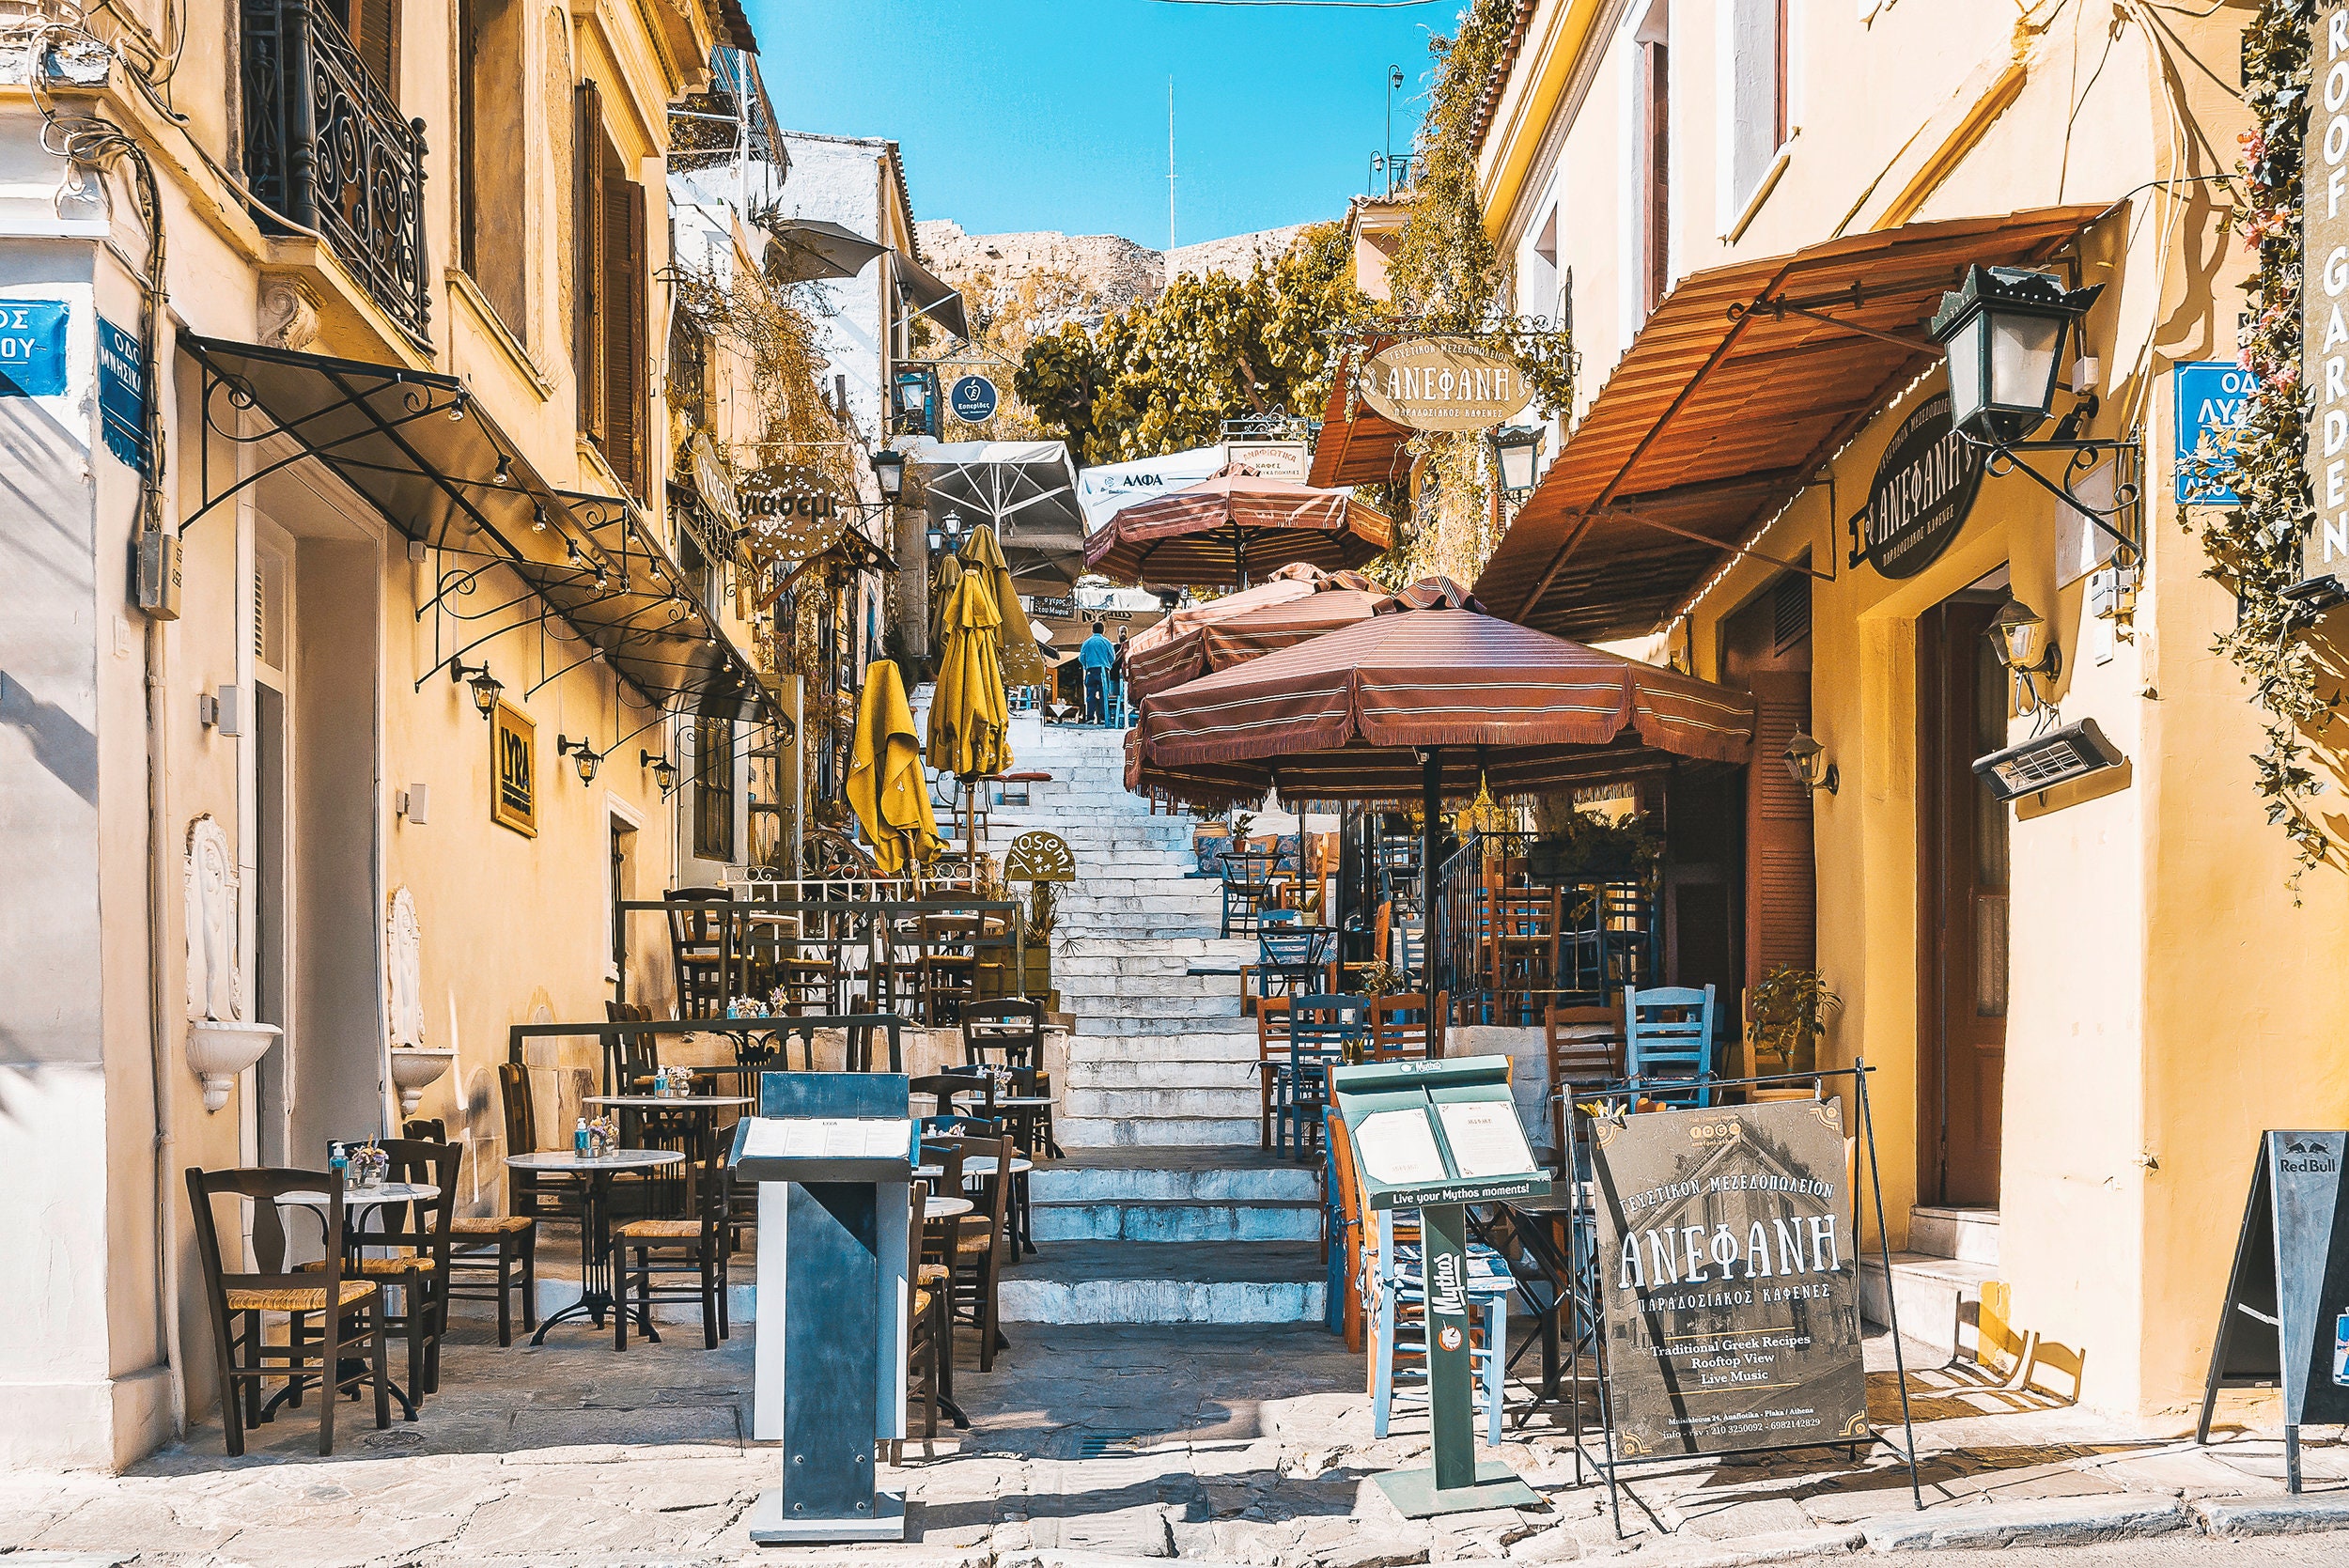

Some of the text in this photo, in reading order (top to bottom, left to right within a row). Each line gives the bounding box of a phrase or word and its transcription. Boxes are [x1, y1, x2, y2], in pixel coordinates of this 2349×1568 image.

[2322, 8, 2349, 565] ROOF GARDEN
[1385, 366, 1510, 401] ΑΝΕΦΑΝΗ
[1123, 474, 1163, 487] ΑΛΦΑ
[1878, 431, 1960, 545] ΑΝΕΦΑΝΗ
[2280, 1158, 2336, 1172] Red Bull
[1392, 1183, 1530, 1204] Live your Mythos moments!
[1619, 1174, 1835, 1215] ΓΕΥΣΤΙΚΟΝ ΜΕΖΕΔΟΠΩΛΕΙΟΝ
[1618, 1214, 1842, 1290] ΑΝΕΦΑΝΗ
[1431, 1252, 1466, 1315] Mythos
[1763, 1283, 1831, 1303] ΚΑΦΕΝΕΣ
[1650, 1335, 1811, 1357] Traditional Greek Recipes
[1691, 1353, 1775, 1369] Rooftop View
[1701, 1369, 1768, 1385] Live Music
[1662, 1430, 1682, 1439] info
[1710, 1425, 1726, 1436] 210
[1728, 1422, 1764, 1434] 3250092
[1770, 1418, 1821, 1430] 6982142829
